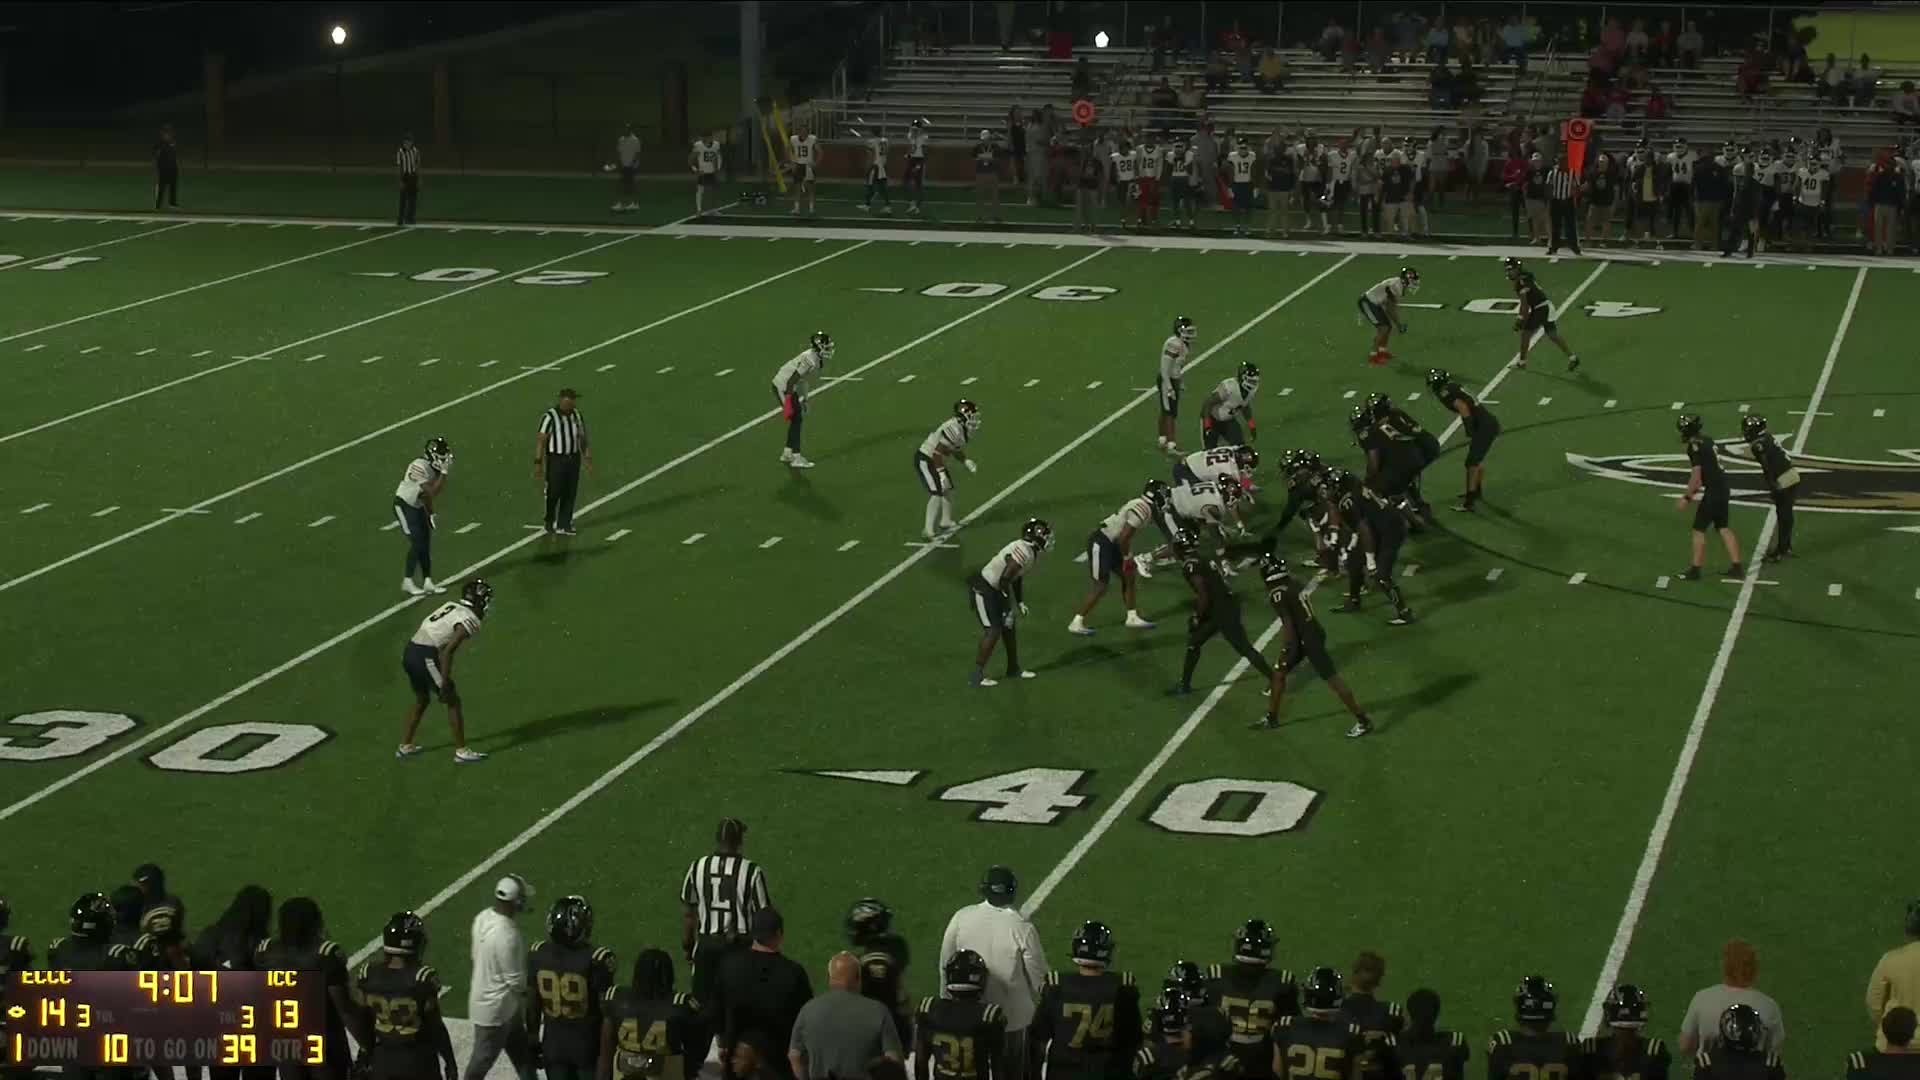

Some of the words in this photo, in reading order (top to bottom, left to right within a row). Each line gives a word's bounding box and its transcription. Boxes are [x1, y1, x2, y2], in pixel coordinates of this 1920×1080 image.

[1804, 178, 1817, 190] 40
[429, 604, 457, 623] 3
[711, 877, 731, 910] L
[536, 969, 589, 1018] 99
[617, 1018, 670, 1053] 44
[1062, 1002, 1116, 1049] 74
[930, 1033, 978, 1078] 31
[1287, 1043, 1345, 1080] 25
